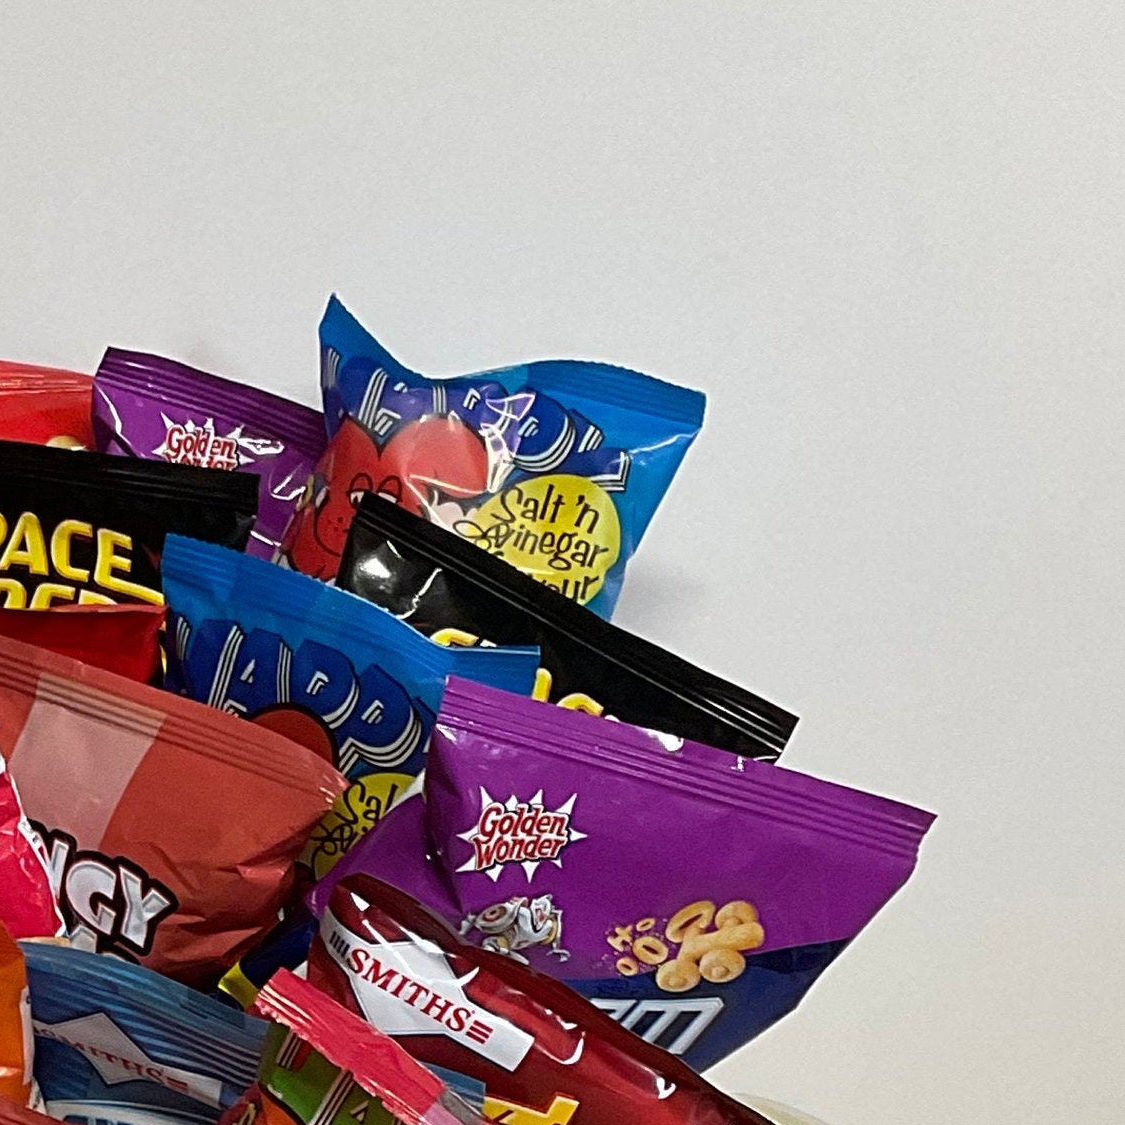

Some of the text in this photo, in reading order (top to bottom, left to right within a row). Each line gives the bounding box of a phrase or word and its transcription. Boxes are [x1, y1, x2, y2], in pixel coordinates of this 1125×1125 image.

[166, 425, 236, 461] Golden
[490, 484, 566, 524] Salt
[335, 779, 398, 826] Sal
[479, 805, 567, 844] Golden
[473, 834, 565, 869] Wonder
[350, 947, 476, 1034] SMITHS
